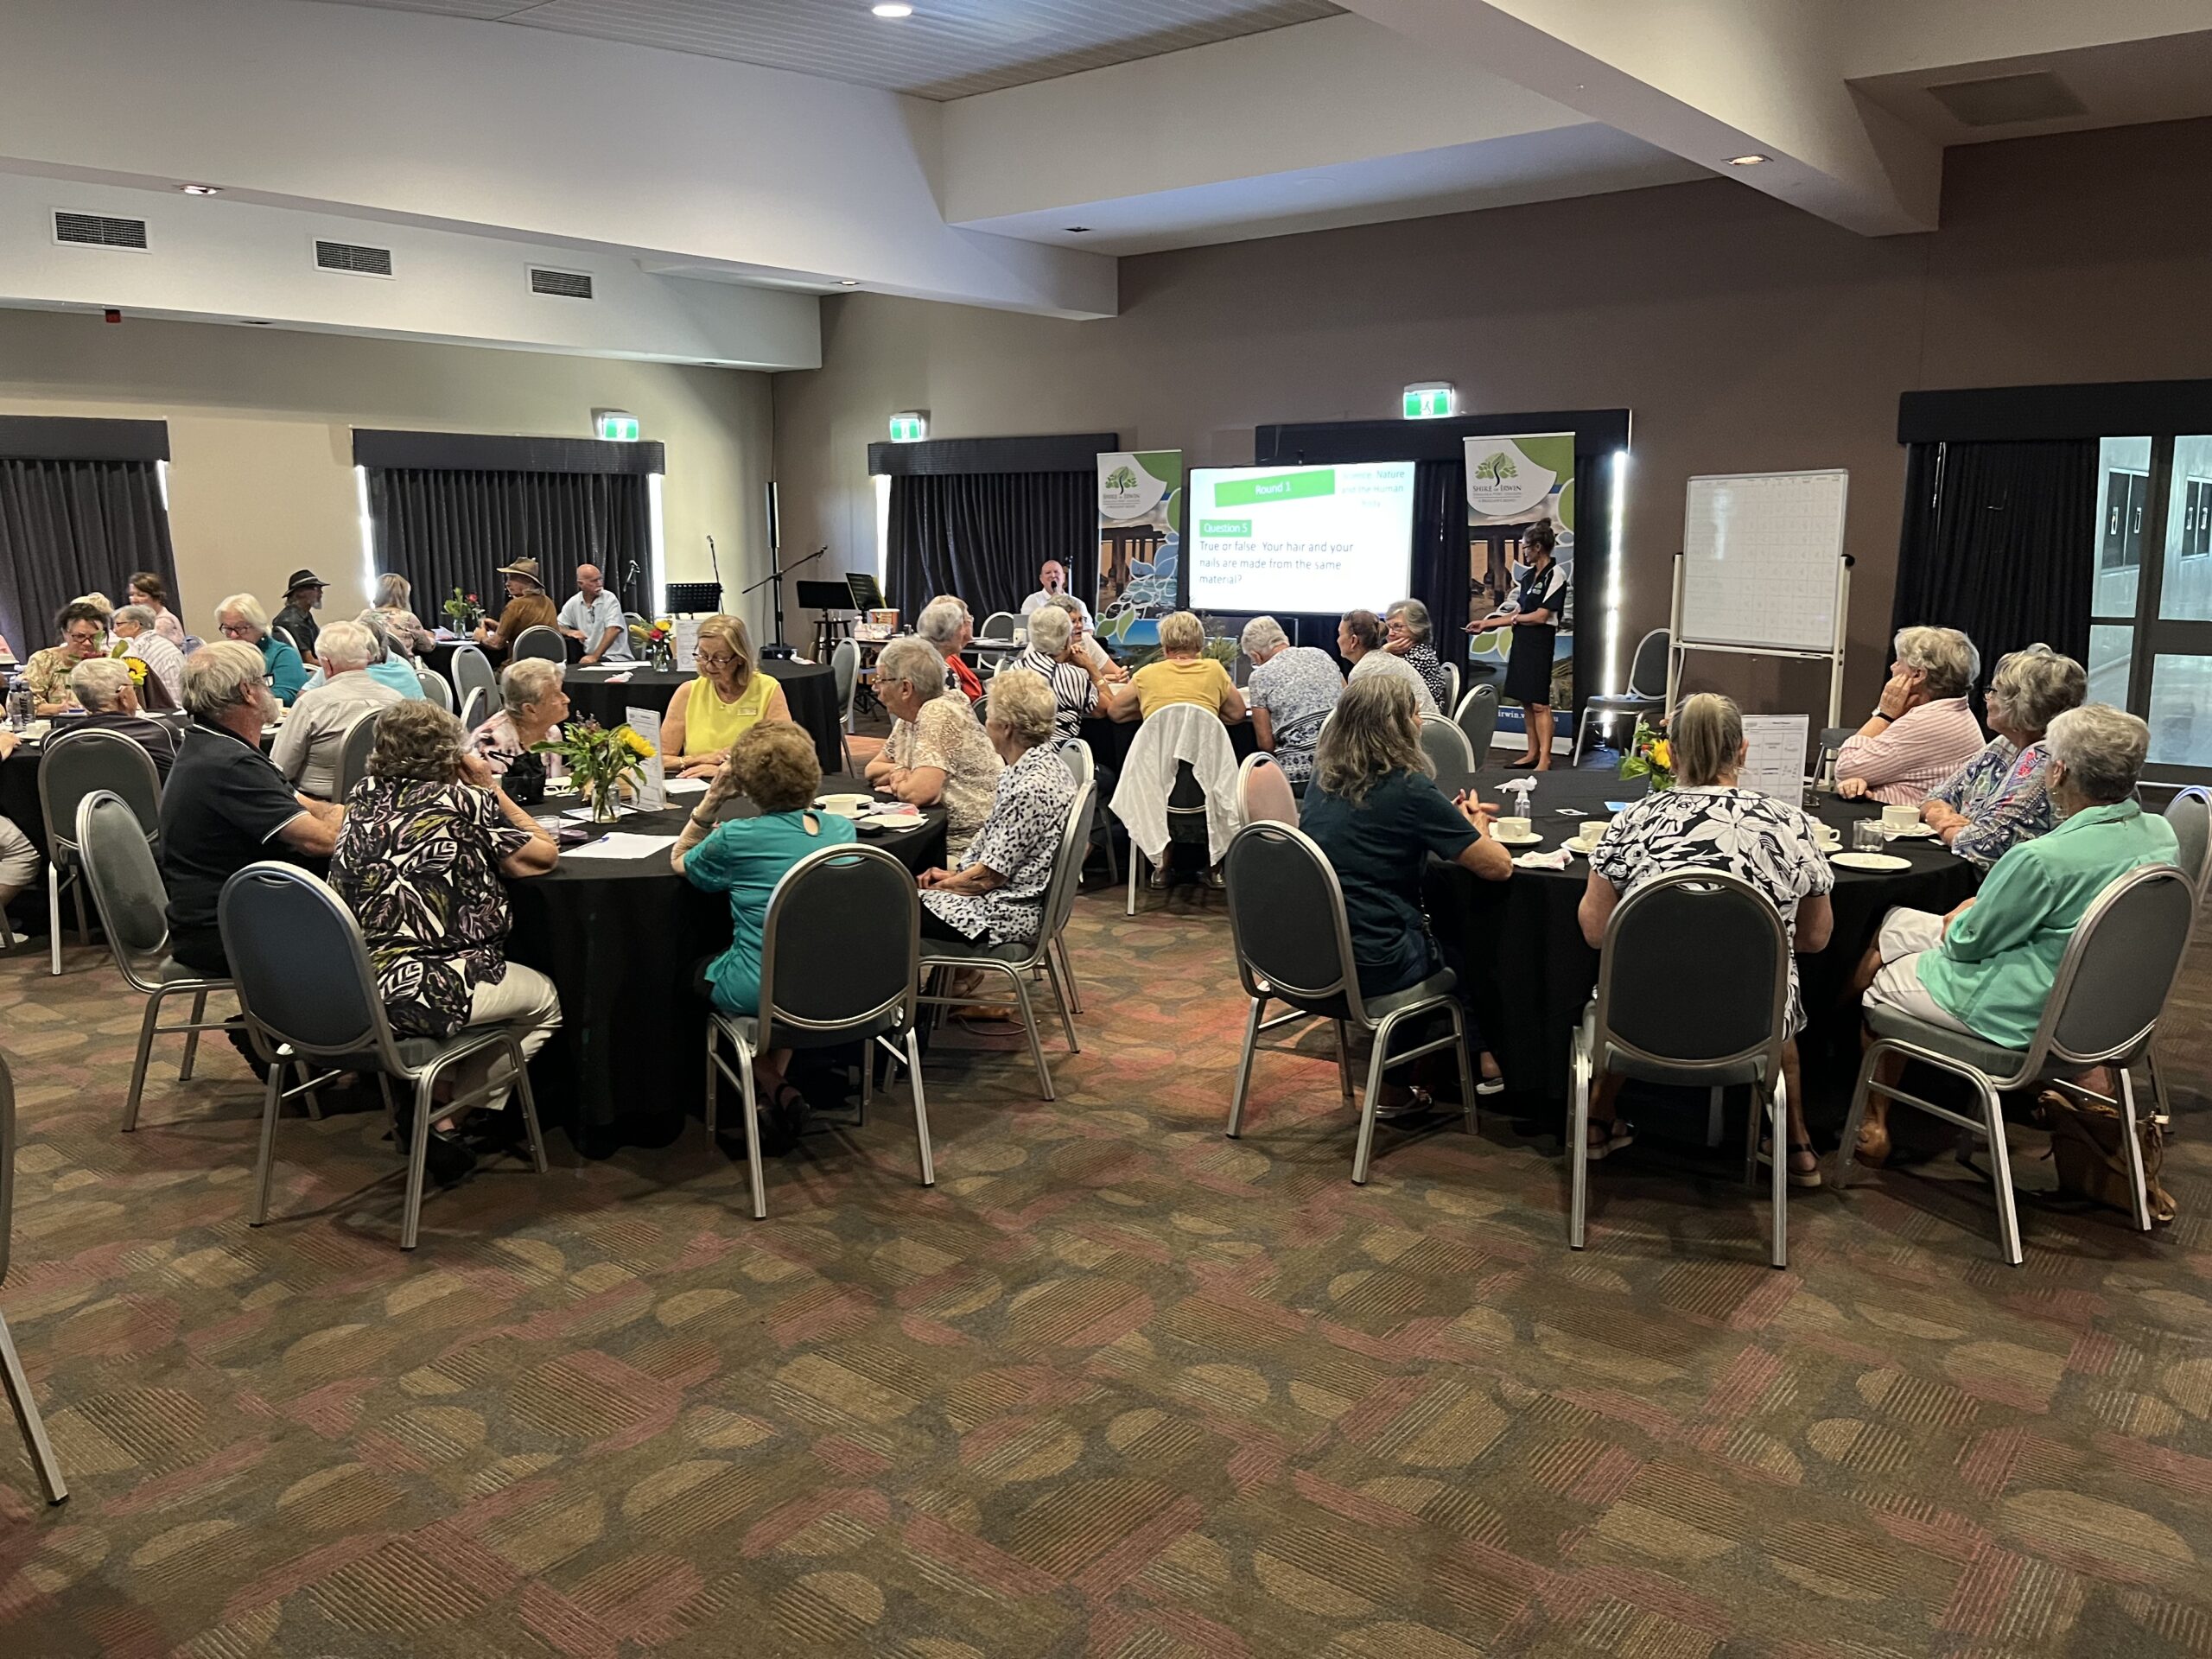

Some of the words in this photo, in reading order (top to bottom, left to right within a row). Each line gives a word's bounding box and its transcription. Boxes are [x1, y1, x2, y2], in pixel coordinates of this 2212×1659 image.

[1376, 470, 1405, 479] Nature
[1255, 482, 1283, 495] Round
[1285, 481, 1291, 492] 1
[1204, 523, 1241, 534] Question
[1242, 523, 1248, 533] 5
[1199, 540, 1219, 551] True
[1262, 541, 1283, 552] Your
[1287, 541, 1306, 552] hair
[1308, 541, 1327, 552] and
[1330, 543, 1354, 554] your
[1199, 557, 1220, 568] nails
[1240, 558, 1266, 569] made
[1268, 557, 1293, 569] from
[1295, 559, 1312, 570] the
[1314, 561, 1341, 570] same
[1199, 574, 1243, 585] material?
